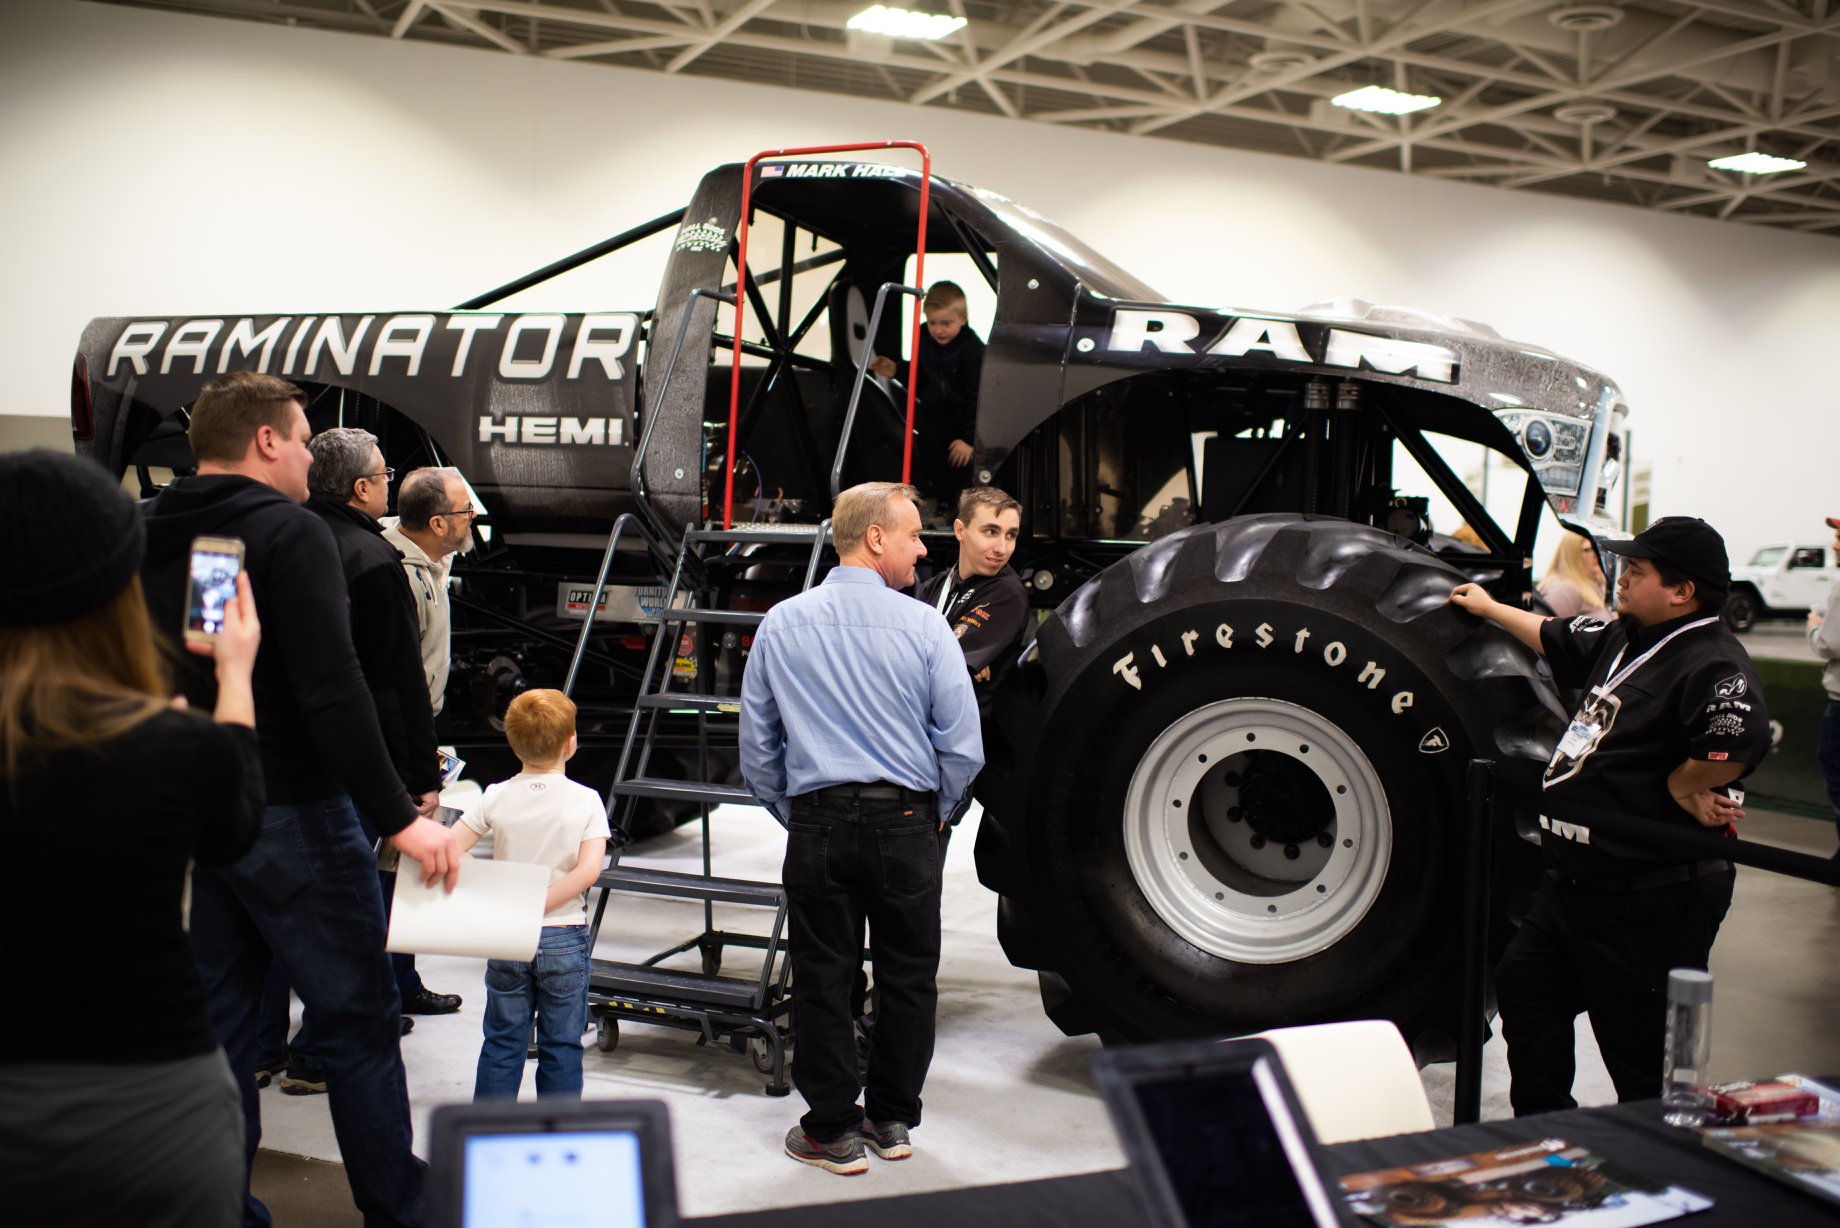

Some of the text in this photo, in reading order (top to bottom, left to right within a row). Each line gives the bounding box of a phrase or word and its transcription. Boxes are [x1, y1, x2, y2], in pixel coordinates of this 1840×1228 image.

[785, 164, 849, 178] MARK
[106, 312, 639, 380] RAMINATOR
[1107, 308, 1457, 384] RAM
[570, 591, 606, 604] OPTIA
[640, 596, 664, 608] WORL
[1112, 622, 1414, 715] Firestone
[1706, 701, 1752, 713] RAM
